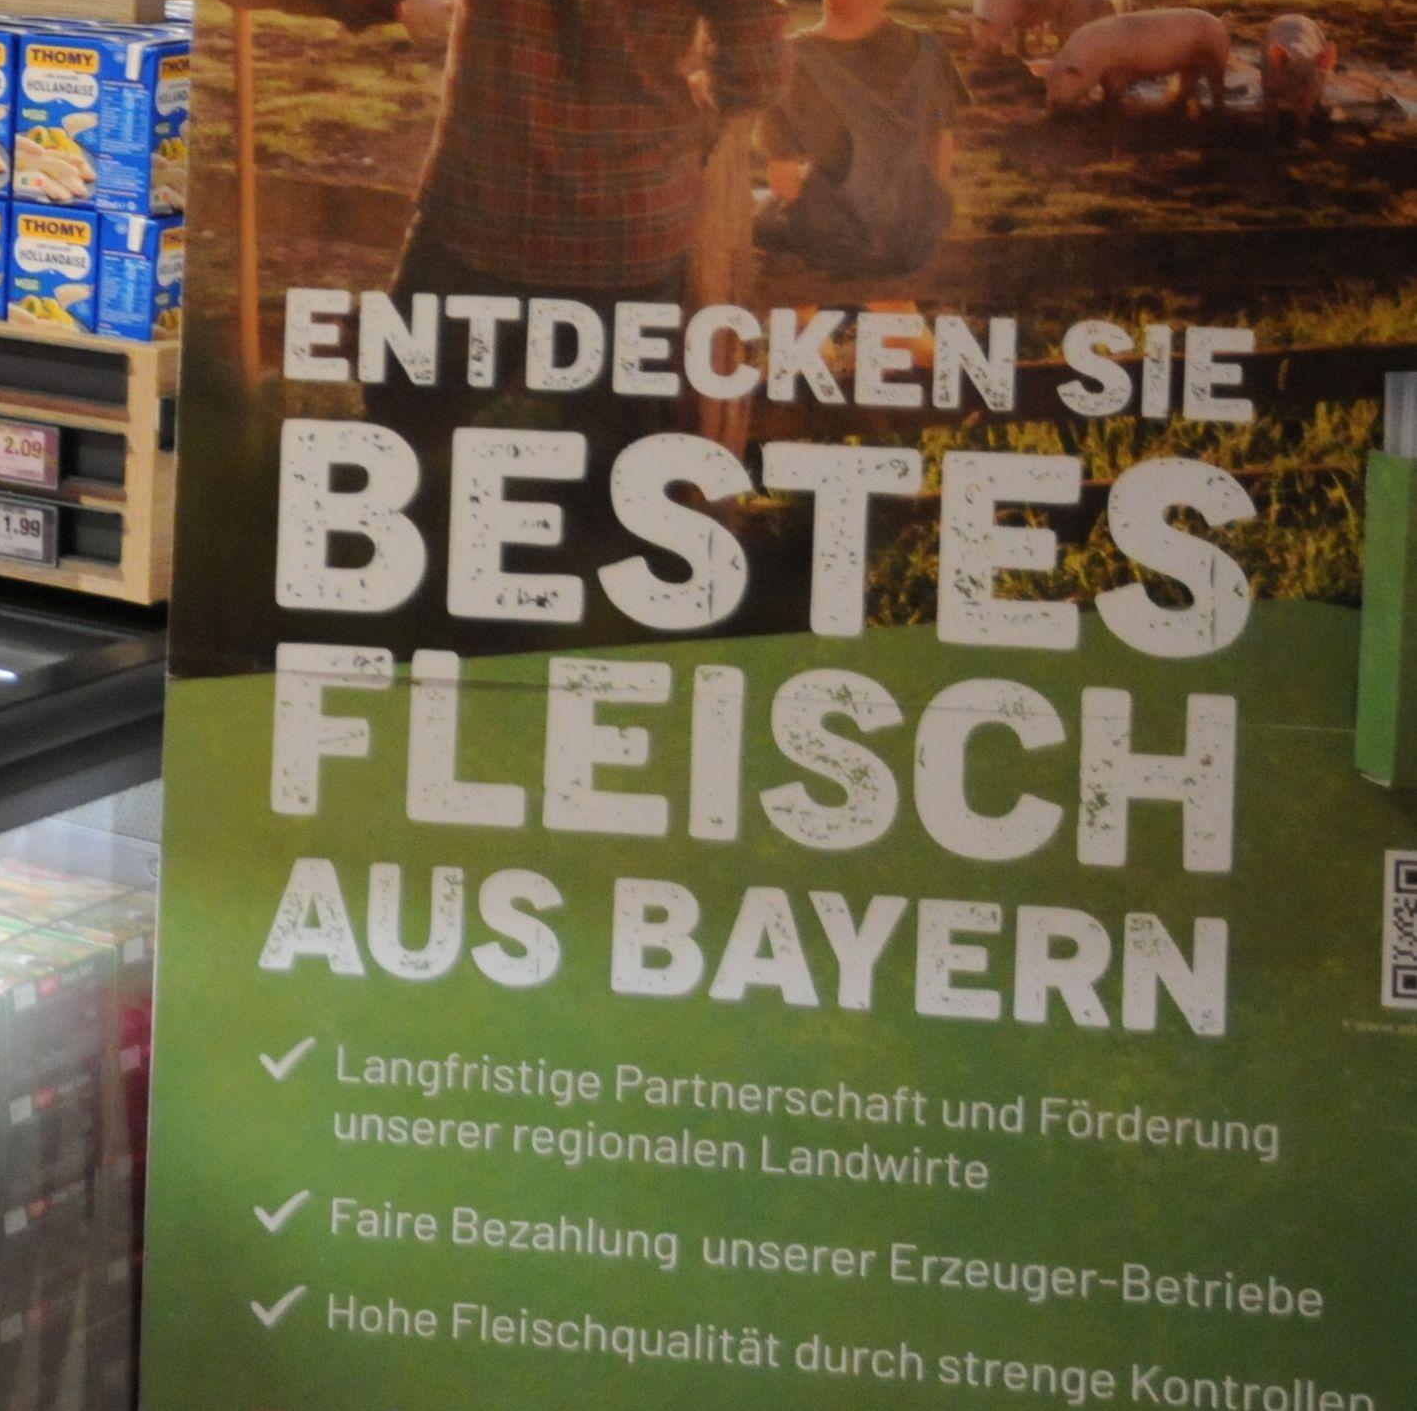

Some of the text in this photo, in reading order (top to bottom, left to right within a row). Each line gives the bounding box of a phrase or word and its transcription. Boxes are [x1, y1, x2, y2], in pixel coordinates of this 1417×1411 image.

[26, 80, 96, 98] HOLLANDAISE
[31, 48, 94, 67] THOMY
[18, 248, 88, 269] HOLLANDAISE
[23, 218, 86, 237] THOMY
[282, 287, 1257, 424] ENTDECKEN SIE
[3, 435, 43, 459] 2.09
[4, 514, 41, 539] 1.99
[273, 417, 1260, 659] BESTES
[268, 640, 1238, 873] FLEISCH
[256, 856, 1230, 1038] AUS BAYERN
[332, 1109, 990, 1190] unserer regionalen Landwirte
[336, 1044, 1281, 1163] Langfristige Partnerschaft und Förderung
[330, 1197, 1325, 1318] Faire Bezahlung unserer Erzeuger-Betriebe
[326, 1291, 1376, 1411] Hohe Fleischqualität durch strenge Kontrollen
